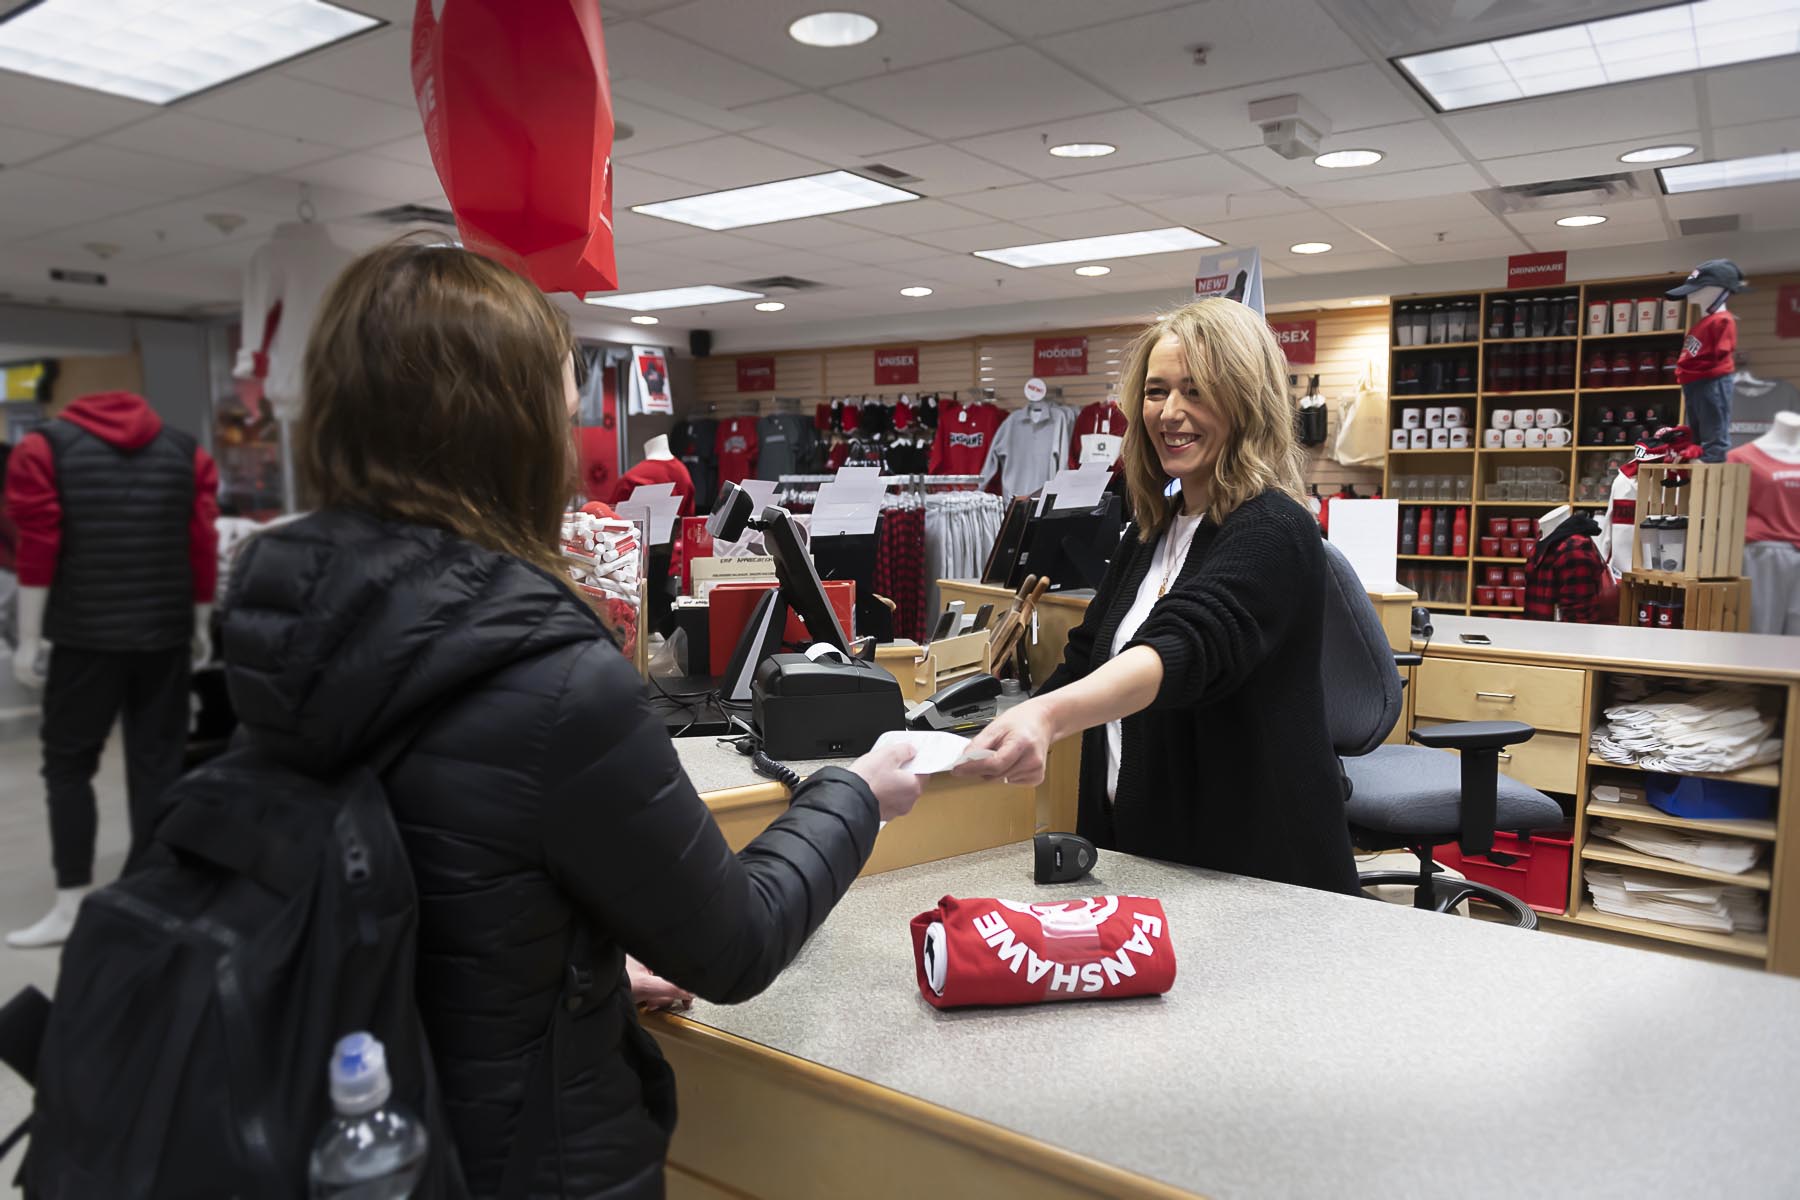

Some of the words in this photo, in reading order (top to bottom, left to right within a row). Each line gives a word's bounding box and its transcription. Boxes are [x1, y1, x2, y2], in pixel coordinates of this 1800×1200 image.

[1510, 263, 1563, 275] DRINKWARE
[1198, 277, 1227, 291] NEW!
[1038, 347, 1083, 359] HOODIES
[877, 356, 914, 367] UNISEX
[972, 910, 1162, 993] FANSHAWE
